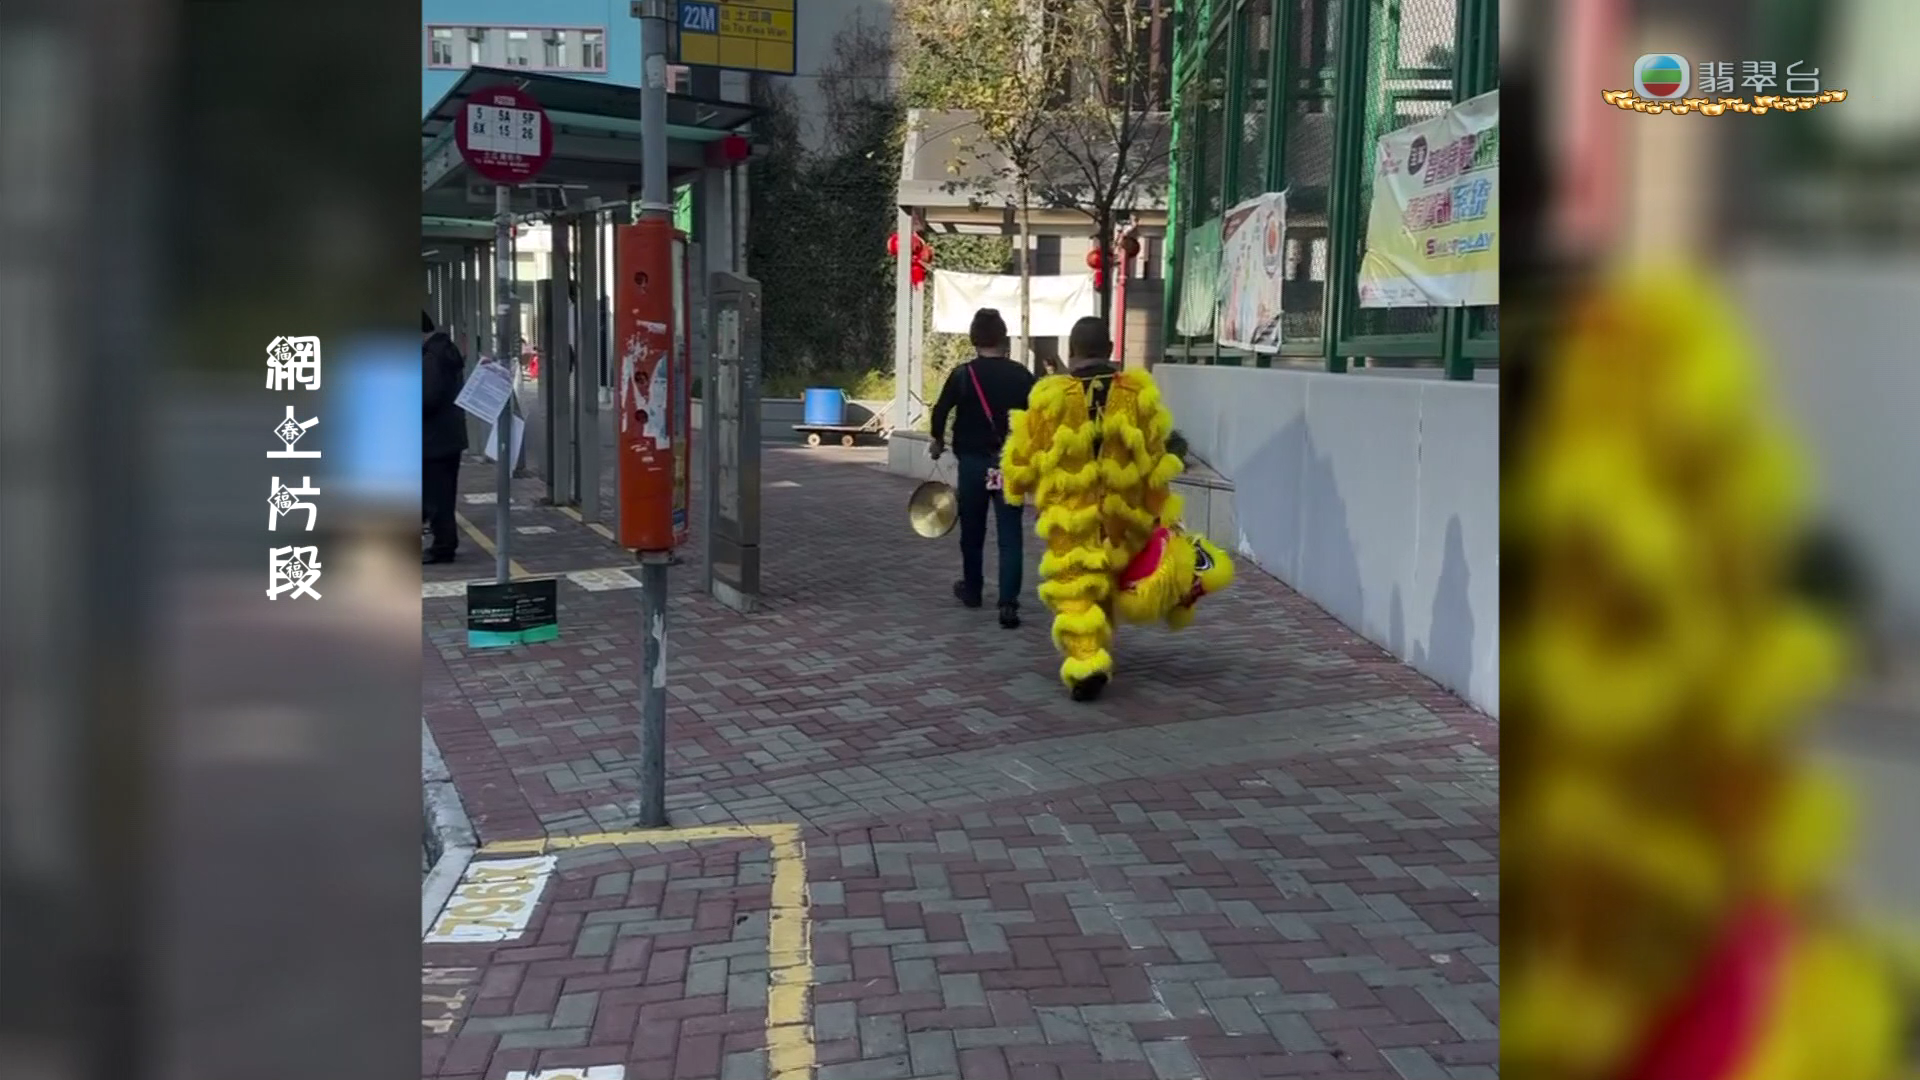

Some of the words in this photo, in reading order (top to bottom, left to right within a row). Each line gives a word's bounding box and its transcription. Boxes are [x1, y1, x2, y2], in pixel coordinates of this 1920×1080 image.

[684, 5, 716, 32] 22M
[477, 107, 483, 119] 5
[498, 110, 510, 122] 5A
[522, 112, 535, 124] 5P
[499, 125, 510, 137] 15
[522, 127, 534, 140] 26
